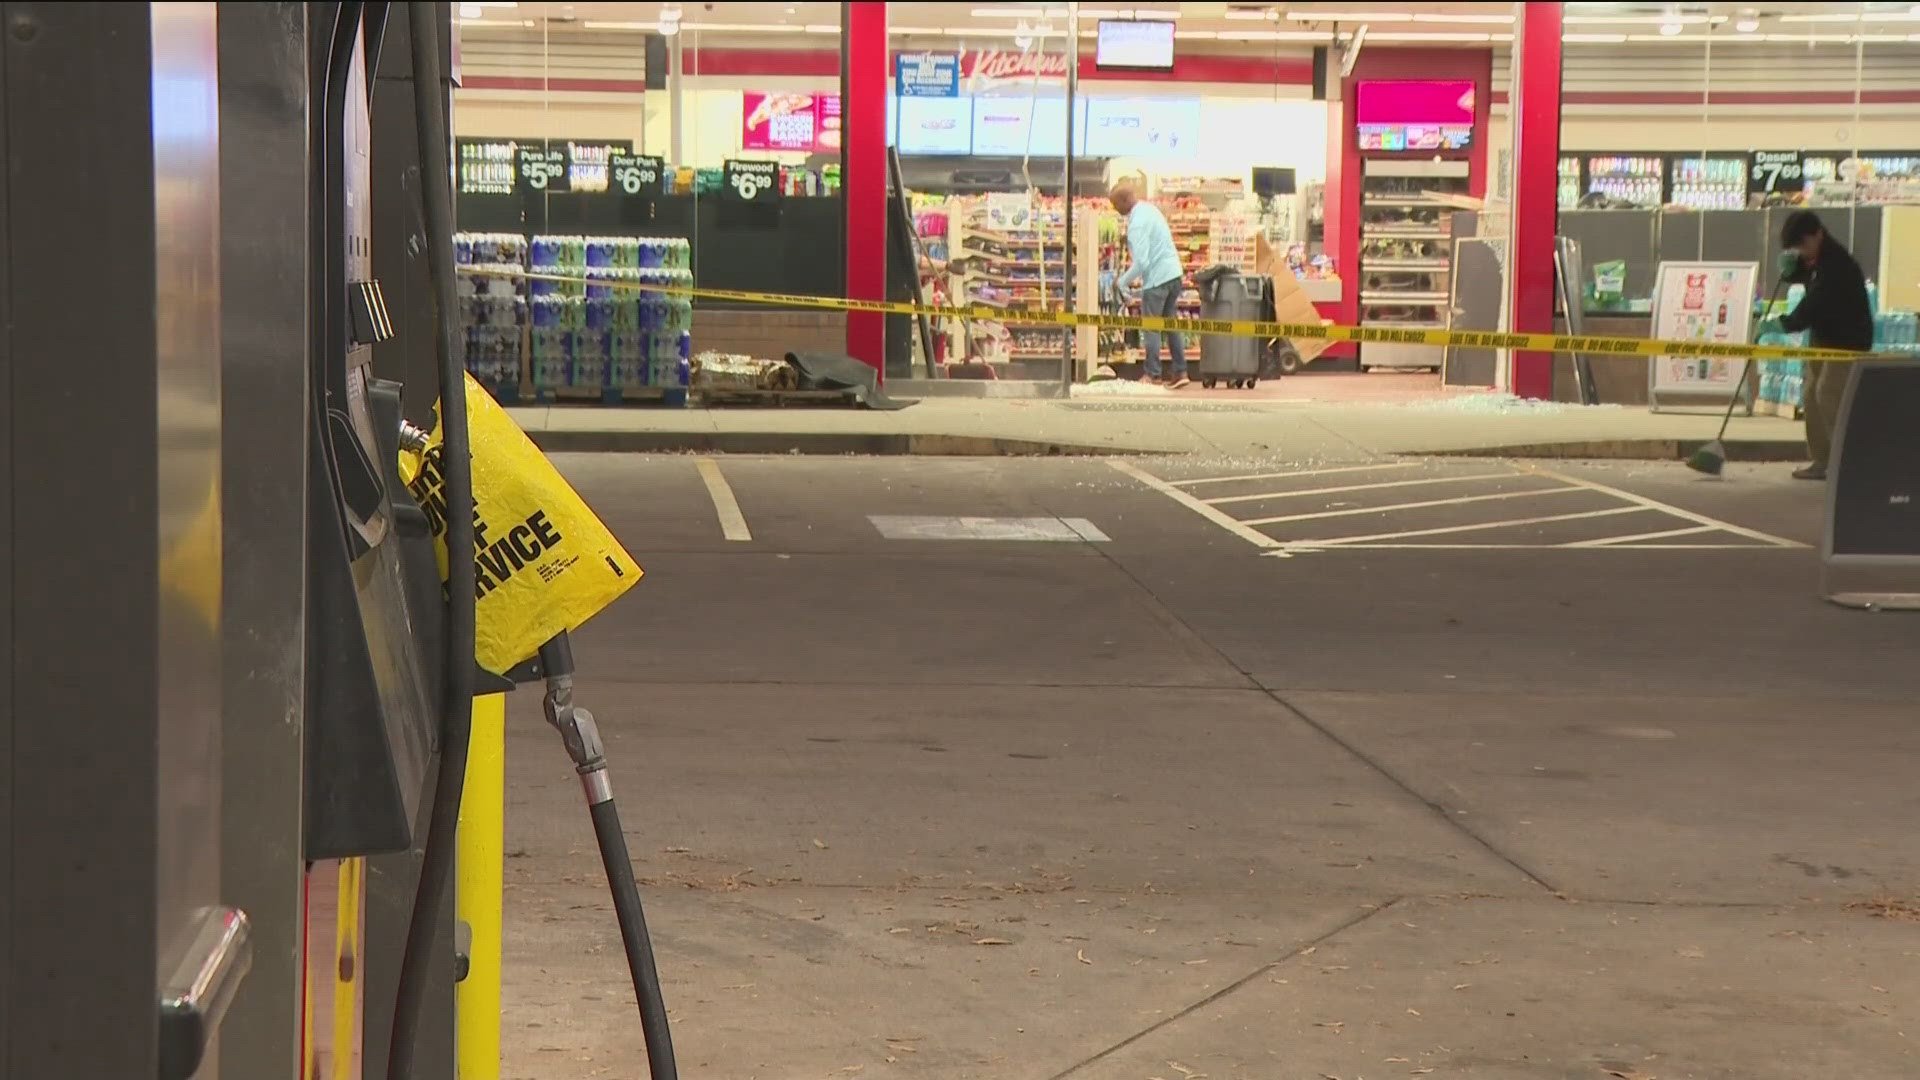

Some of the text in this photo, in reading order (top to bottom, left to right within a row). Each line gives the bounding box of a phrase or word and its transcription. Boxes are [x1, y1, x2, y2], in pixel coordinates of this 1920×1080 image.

[521, 151, 563, 161] Pure Life
[613, 156, 658, 167] Deer Park
[1756, 152, 1797, 163] Dasani
[730, 161, 774, 172] Firewood
[474, 509, 562, 600] RVICE
